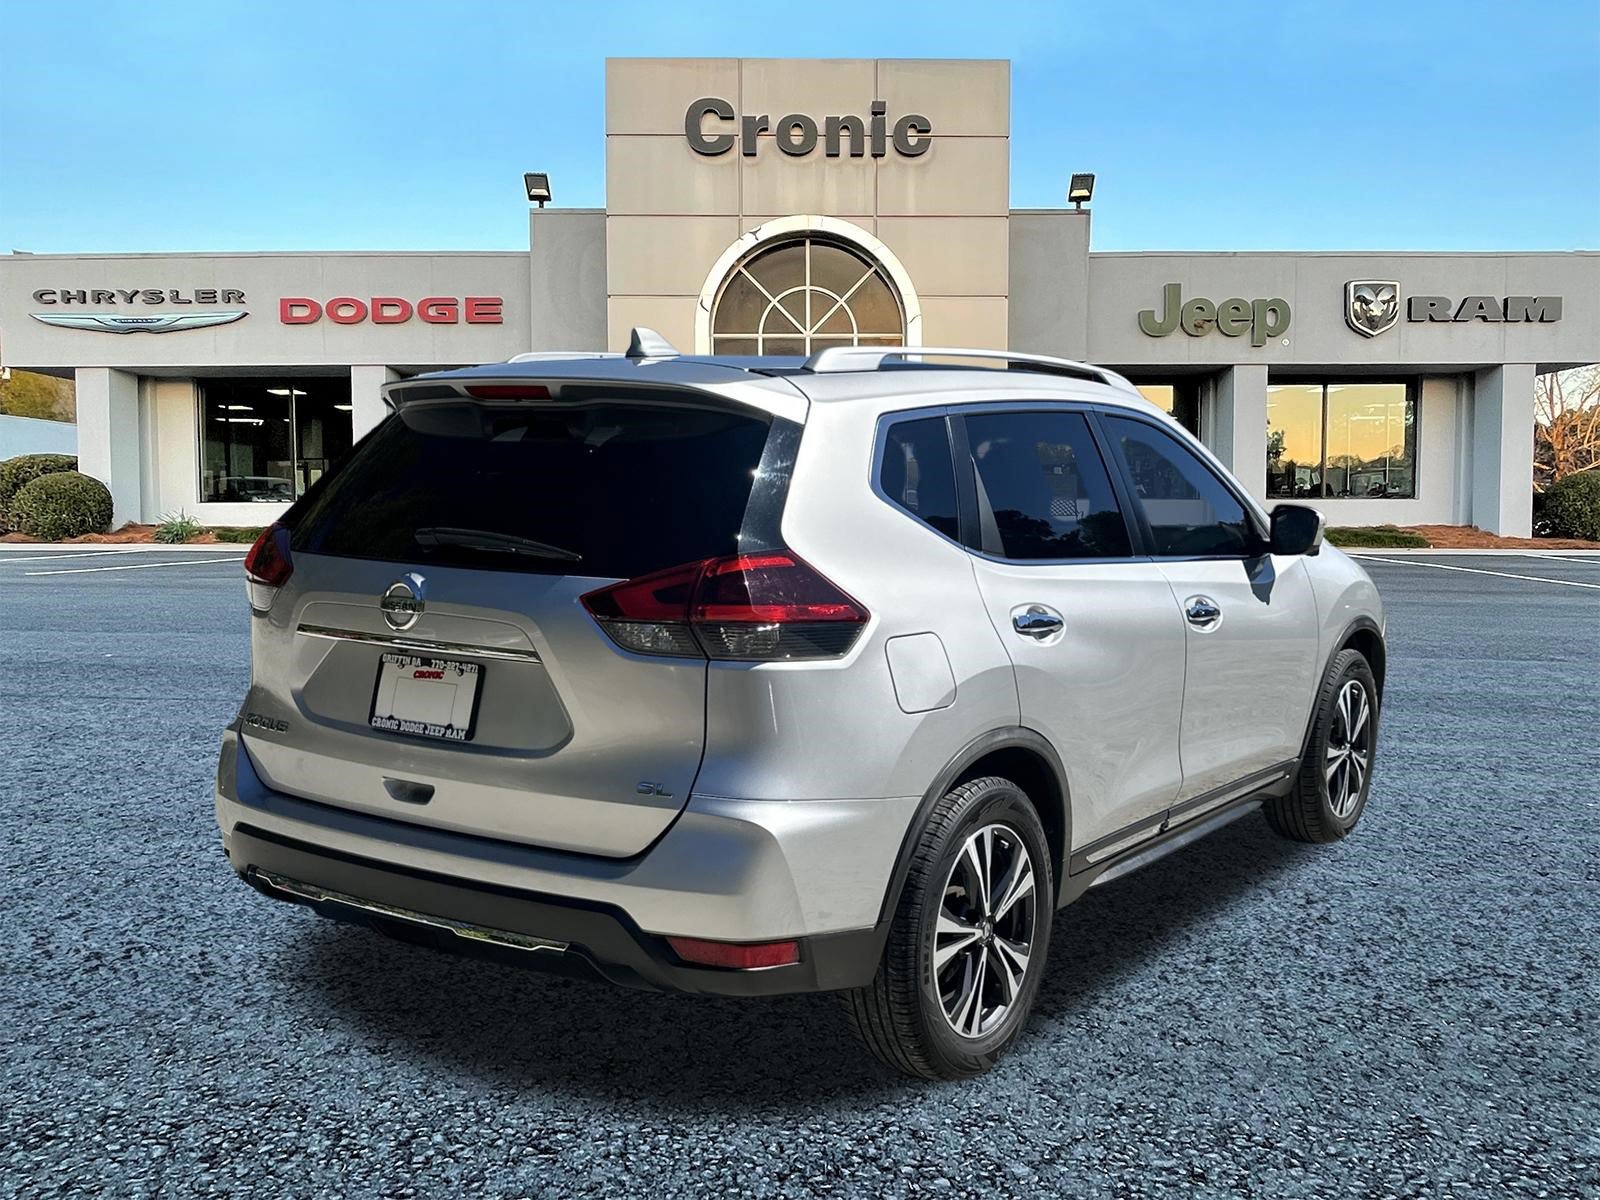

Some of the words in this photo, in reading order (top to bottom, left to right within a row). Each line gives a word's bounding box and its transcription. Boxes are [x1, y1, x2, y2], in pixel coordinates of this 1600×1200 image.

[685, 97, 932, 157] Cronic
[33, 288, 247, 304] CHRYSLER
[1407, 296, 1562, 322] RAM
[280, 297, 503, 325] DODGE
[1138, 283, 1291, 347] Jeep
[371, 716, 399, 730] CRONIC
[400, 721, 425, 734] DODGE
[425, 724, 445, 737] JEEP
[445, 728, 466, 740] RAM
[636, 781, 673, 799] SL
